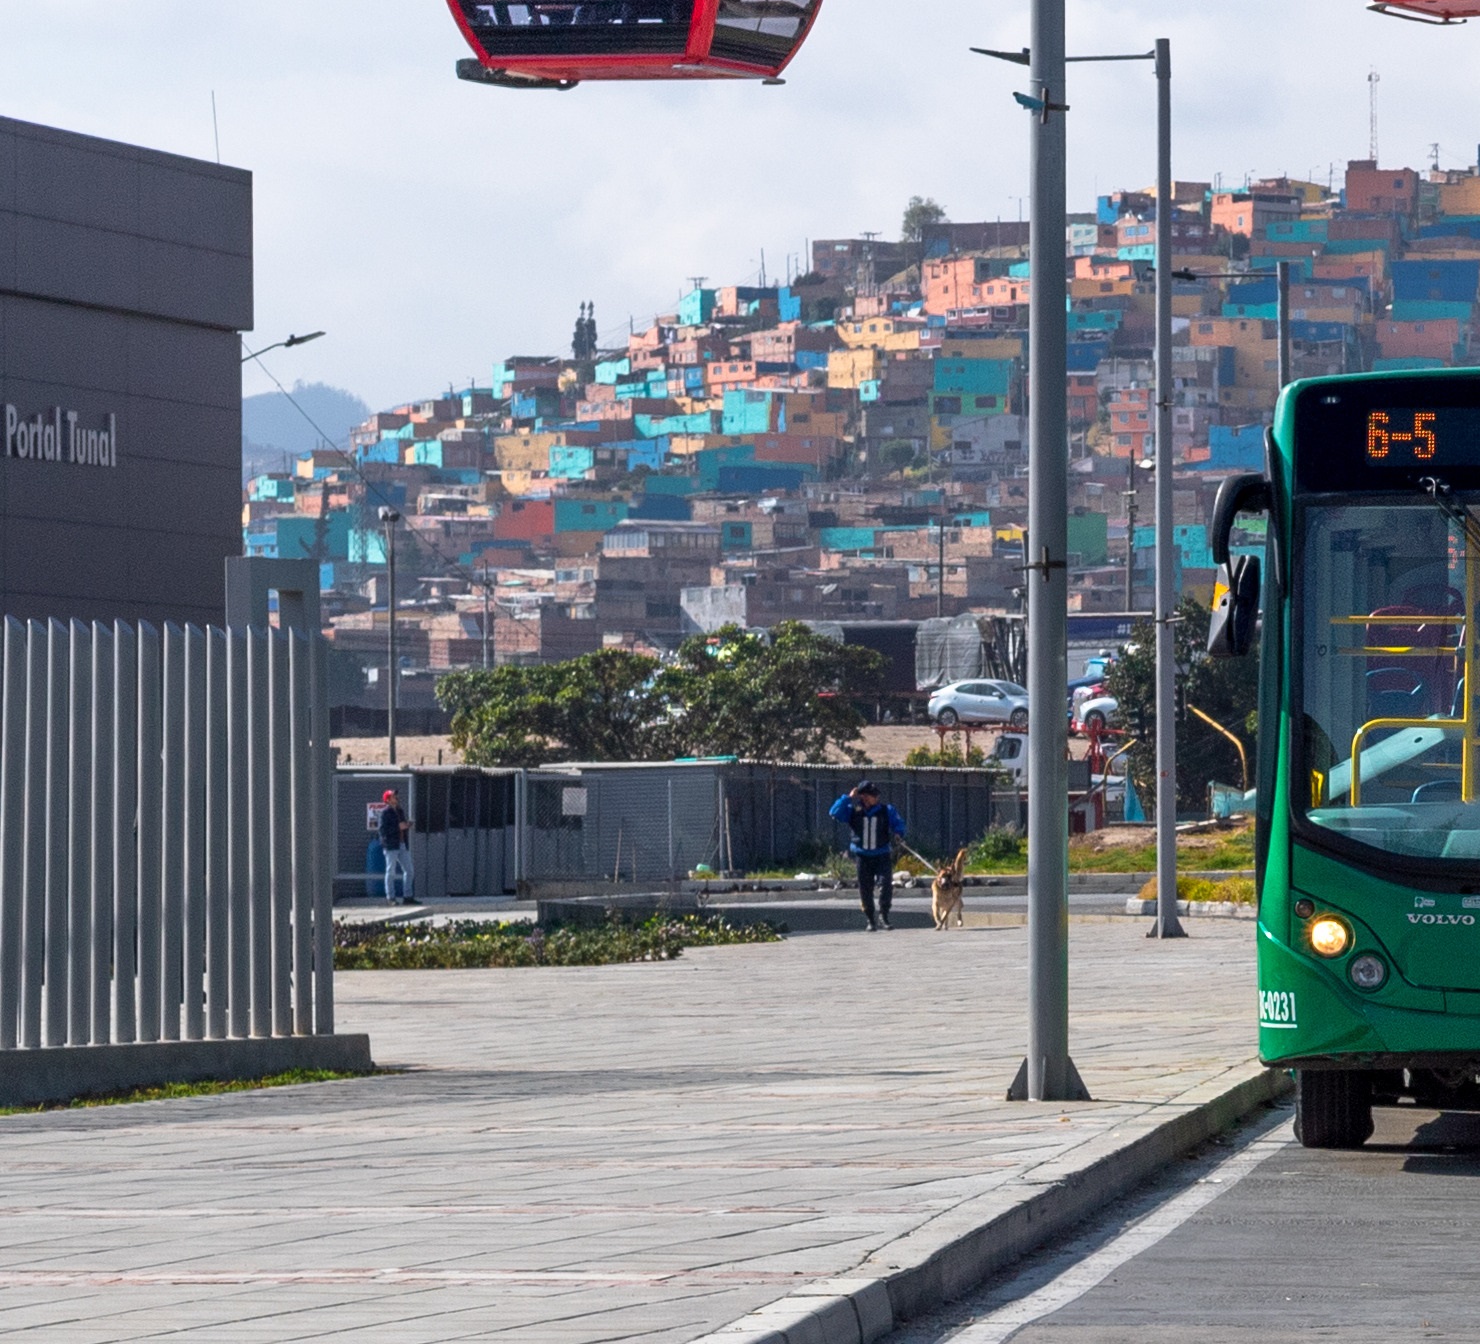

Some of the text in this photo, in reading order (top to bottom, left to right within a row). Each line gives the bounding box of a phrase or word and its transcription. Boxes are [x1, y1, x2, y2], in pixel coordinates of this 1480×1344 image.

[5, 403, 117, 467] Portal Tunal
[1368, 412, 1436, 458] 6-5
[1406, 913, 1475, 926] VOLVO
